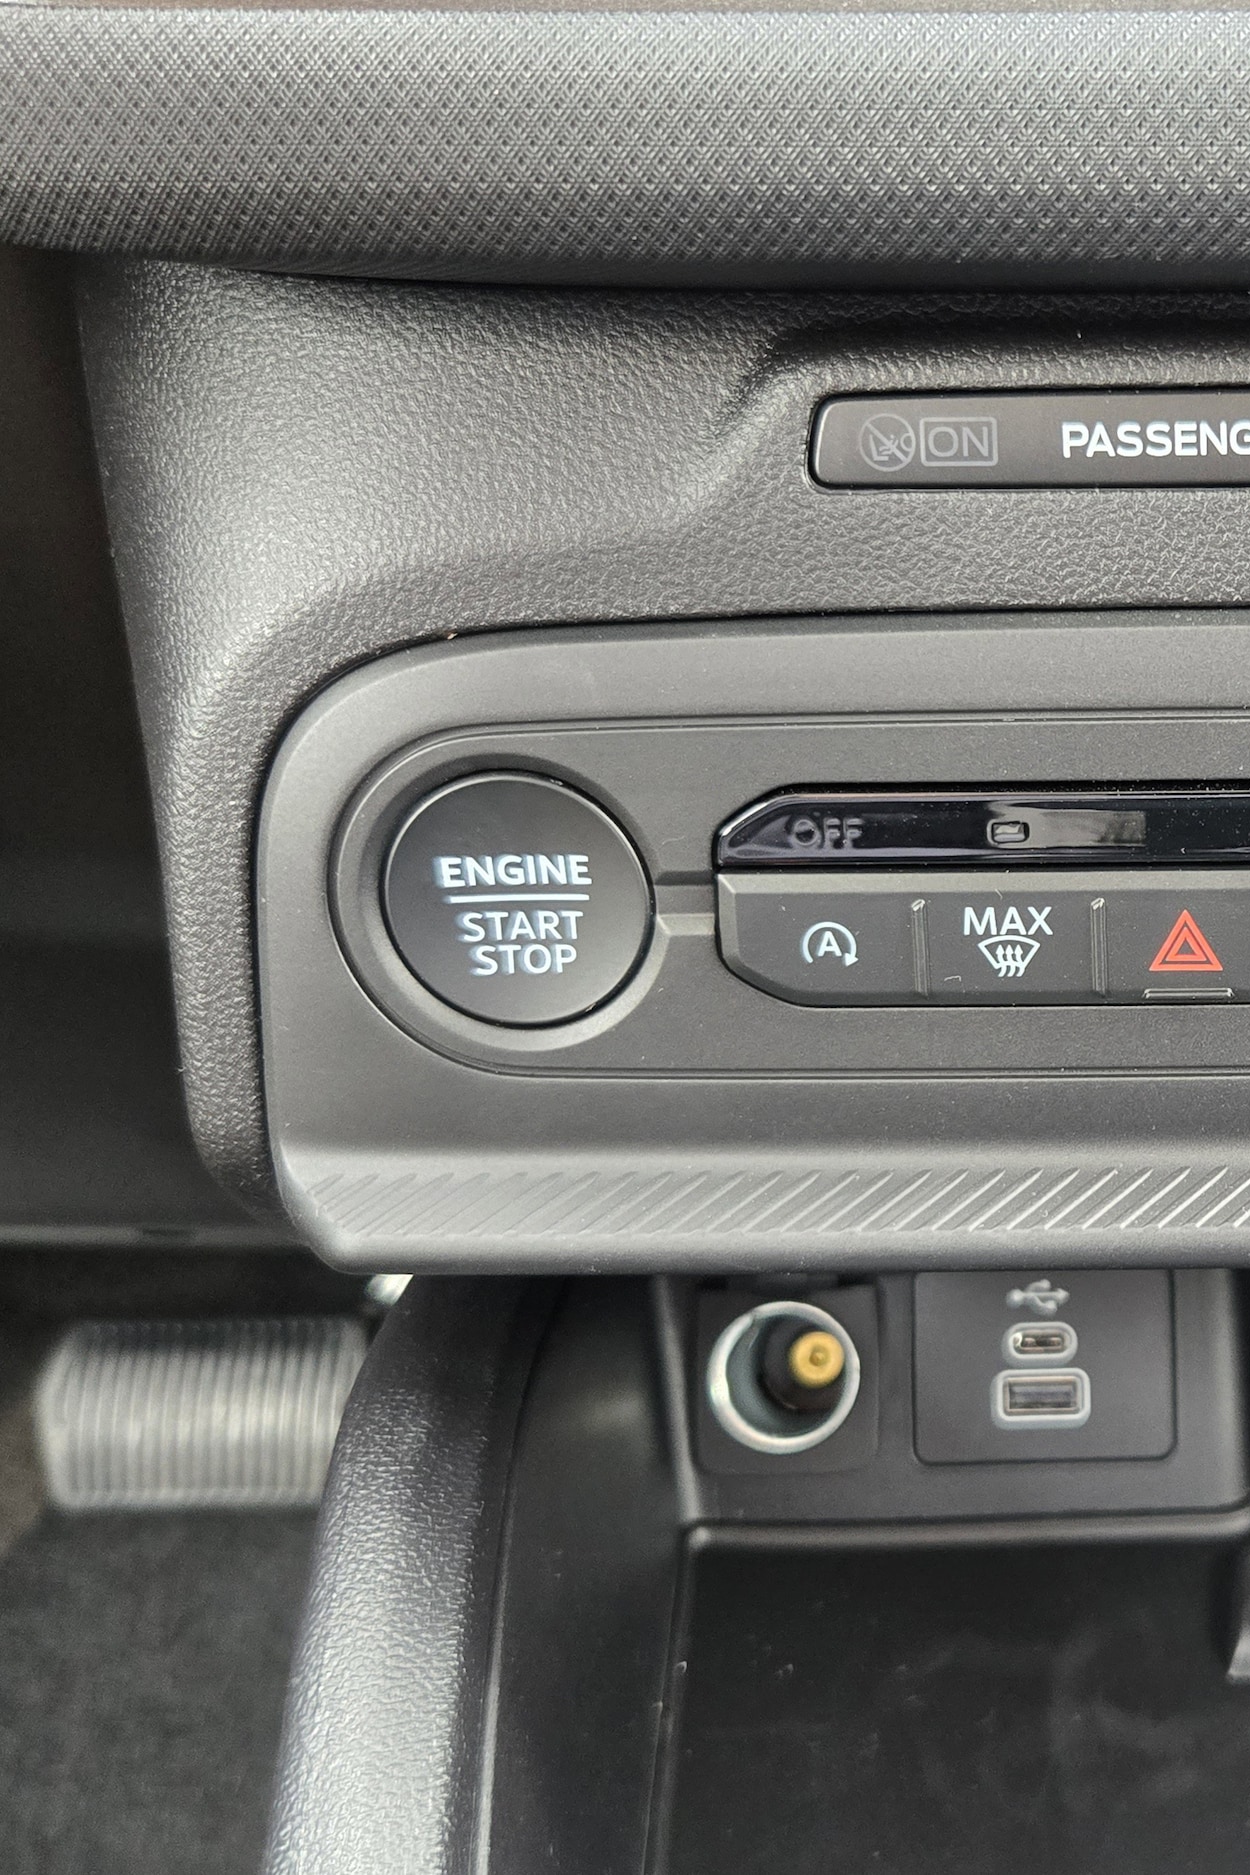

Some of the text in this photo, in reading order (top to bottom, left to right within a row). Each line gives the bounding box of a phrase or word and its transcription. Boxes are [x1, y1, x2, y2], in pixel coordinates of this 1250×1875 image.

[927, 425, 991, 458] ON
[788, 817, 864, 850] OFF
[436, 854, 593, 888] ENGINE
[458, 910, 584, 943] START
[963, 906, 1054, 936] MAX
[471, 944, 578, 977] STOP
